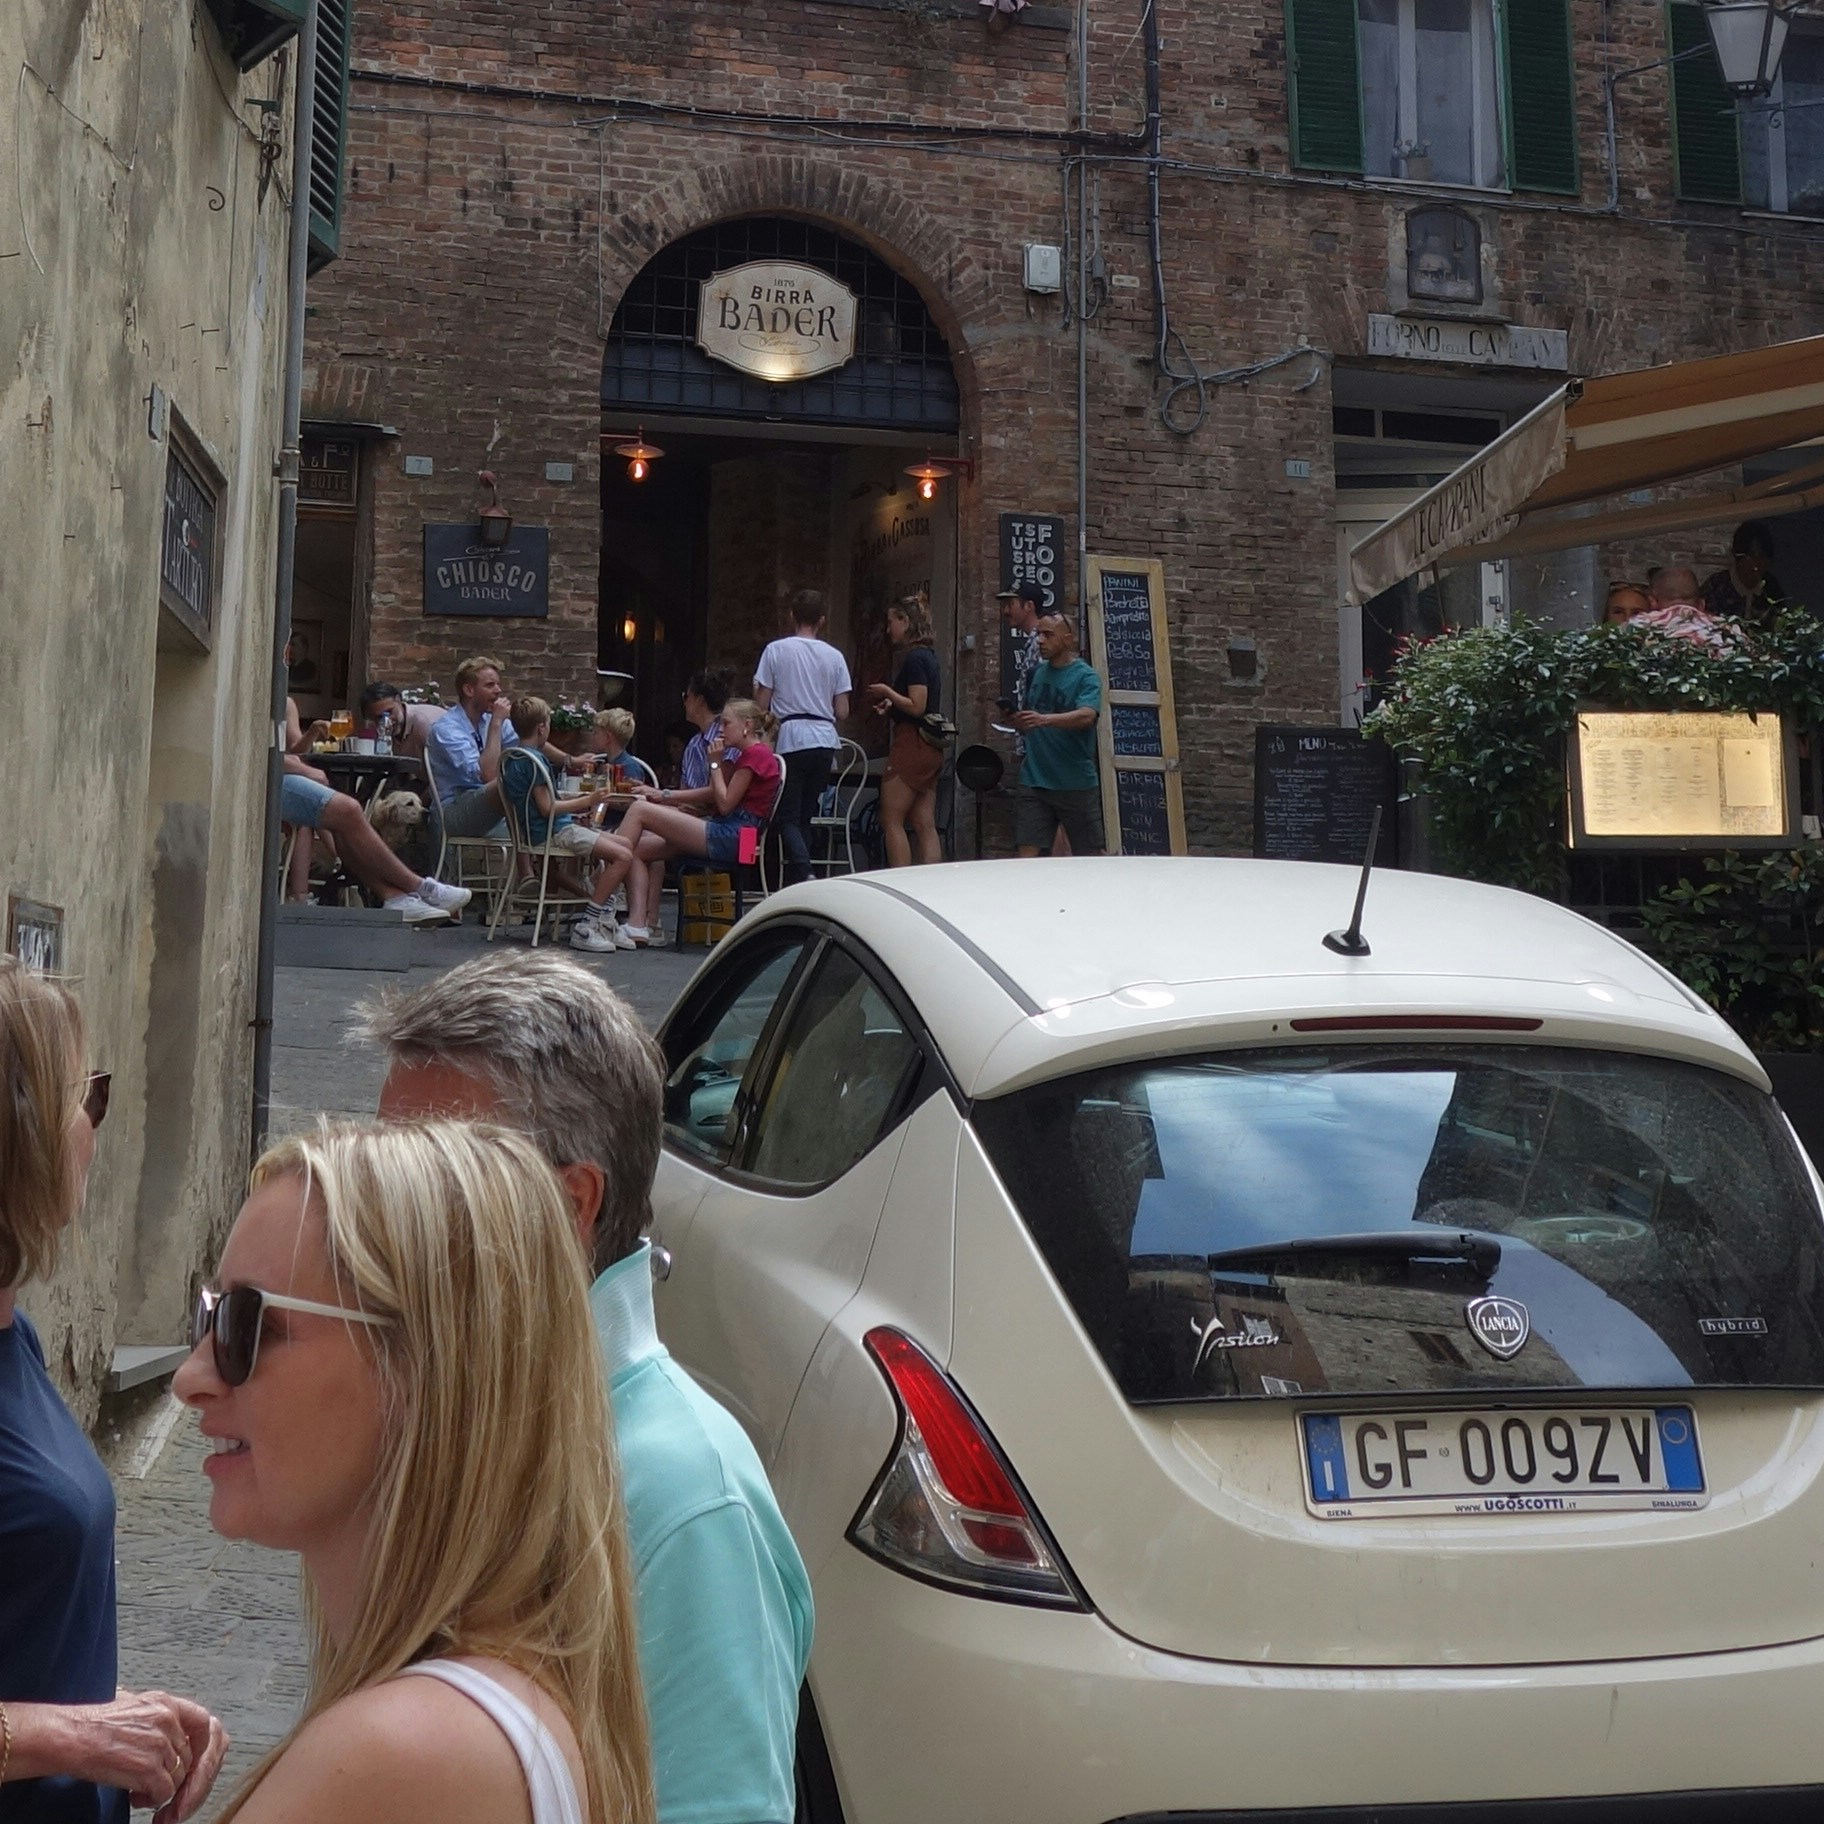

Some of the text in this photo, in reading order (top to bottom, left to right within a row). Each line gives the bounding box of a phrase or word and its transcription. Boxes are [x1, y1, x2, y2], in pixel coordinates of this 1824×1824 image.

[750, 284, 815, 305] BIRRA
[719, 296, 840, 343] BADER
[1371, 320, 1441, 353] FORNO
[1469, 329, 1552, 363] CAMPAN
[415, 459, 424, 471] 7
[1011, 522, 1025, 591] TUSCA
[1025, 523, 1036, 584] STRE
[436, 560, 537, 593] CHIOSCO
[1103, 576, 1139, 589] PANINI
[461, 586, 512, 602] BADER
[1481, 1316, 1520, 1331] LANCIA
[1706, 1320, 1760, 1333] hybrid
[1355, 1420, 1428, 1490] GF
[1459, 1417, 1654, 1486] 009ZV
